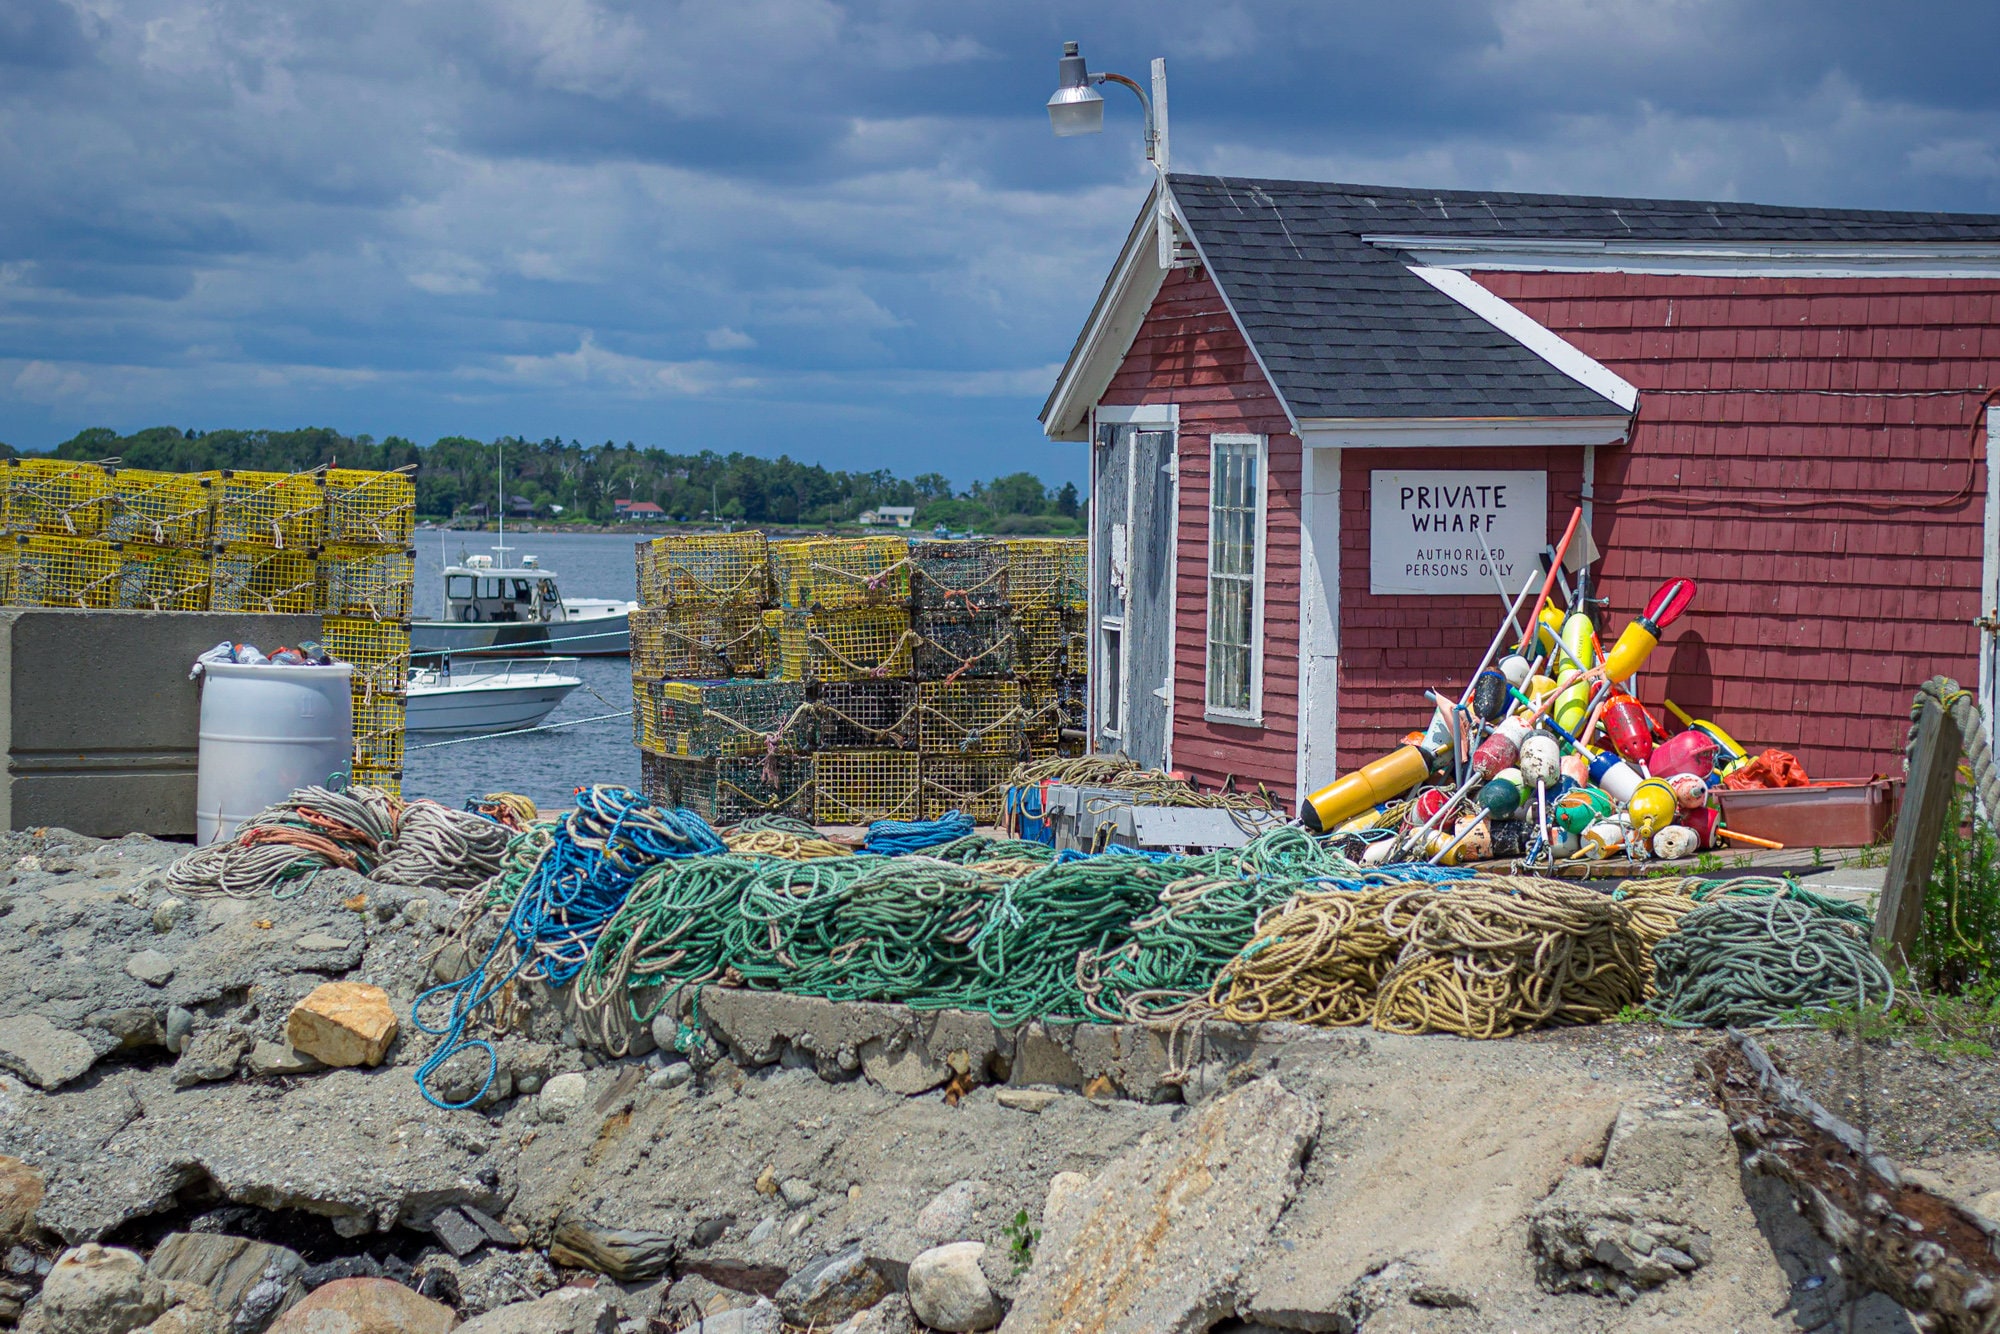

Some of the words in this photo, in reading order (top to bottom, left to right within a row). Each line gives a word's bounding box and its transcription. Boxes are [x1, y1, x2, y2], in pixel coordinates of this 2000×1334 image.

[1401, 486, 1507, 510] PRIVATE
[1412, 513, 1497, 532] WHARF
[1416, 548, 1505, 561] AUTHORIZED
[1406, 563, 1468, 576] PERSONS
